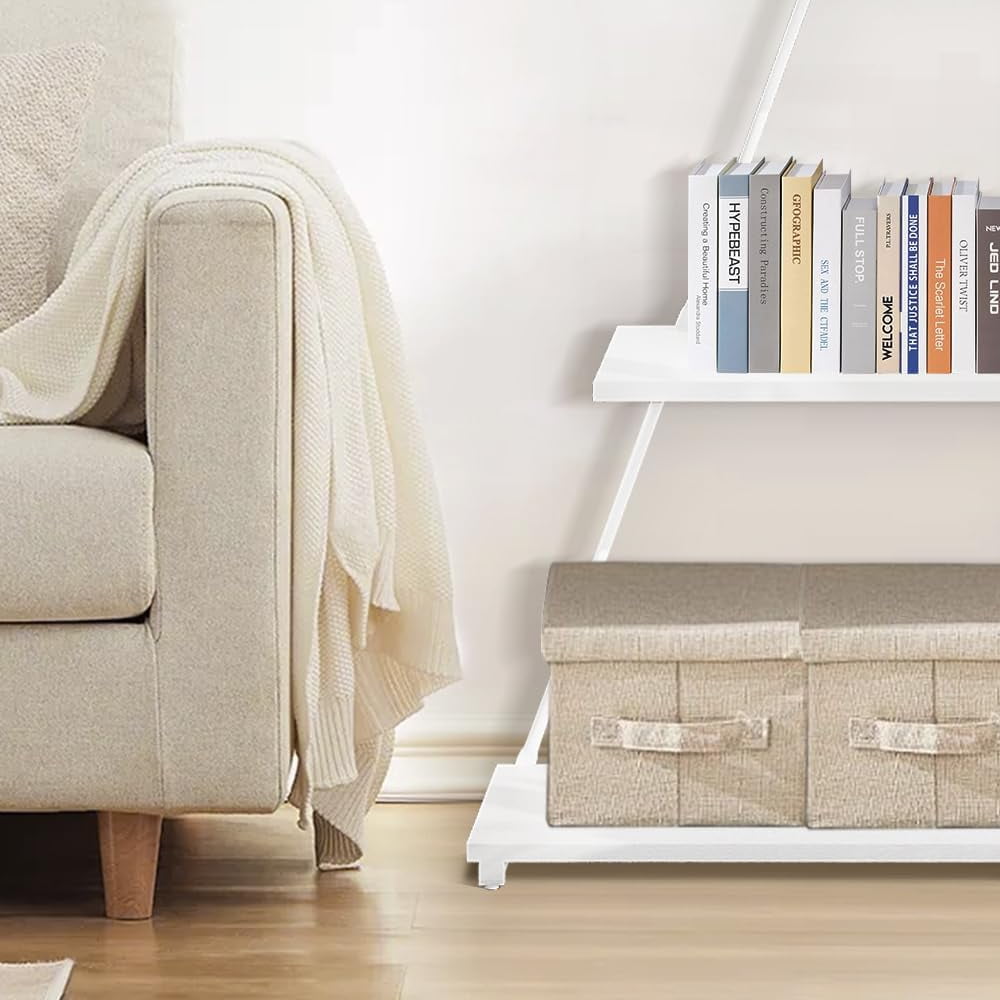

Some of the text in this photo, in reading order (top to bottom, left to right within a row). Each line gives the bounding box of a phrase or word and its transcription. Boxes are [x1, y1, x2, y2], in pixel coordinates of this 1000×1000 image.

[701, 203, 710, 237] Creating
[728, 203, 740, 284] HYPEBEAST
[855, 217, 865, 248] FULL
[701, 245, 710, 280] Beautiful
[758, 188, 769, 305] Constructing Paradies
[820, 260, 829, 275] SEX
[702, 282, 710, 306] Home
[820, 279, 829, 295] AND
[909, 214, 918, 351] THAT JUSTICE SHALL BE DONE
[959, 239, 968, 312] OLIVER TWIST
[989, 242, 999, 314] JED LIND
[820, 298, 829, 313] THE
[882, 296, 893, 360] WELCOME
[934, 258, 946, 351] The Scarlet Letter
